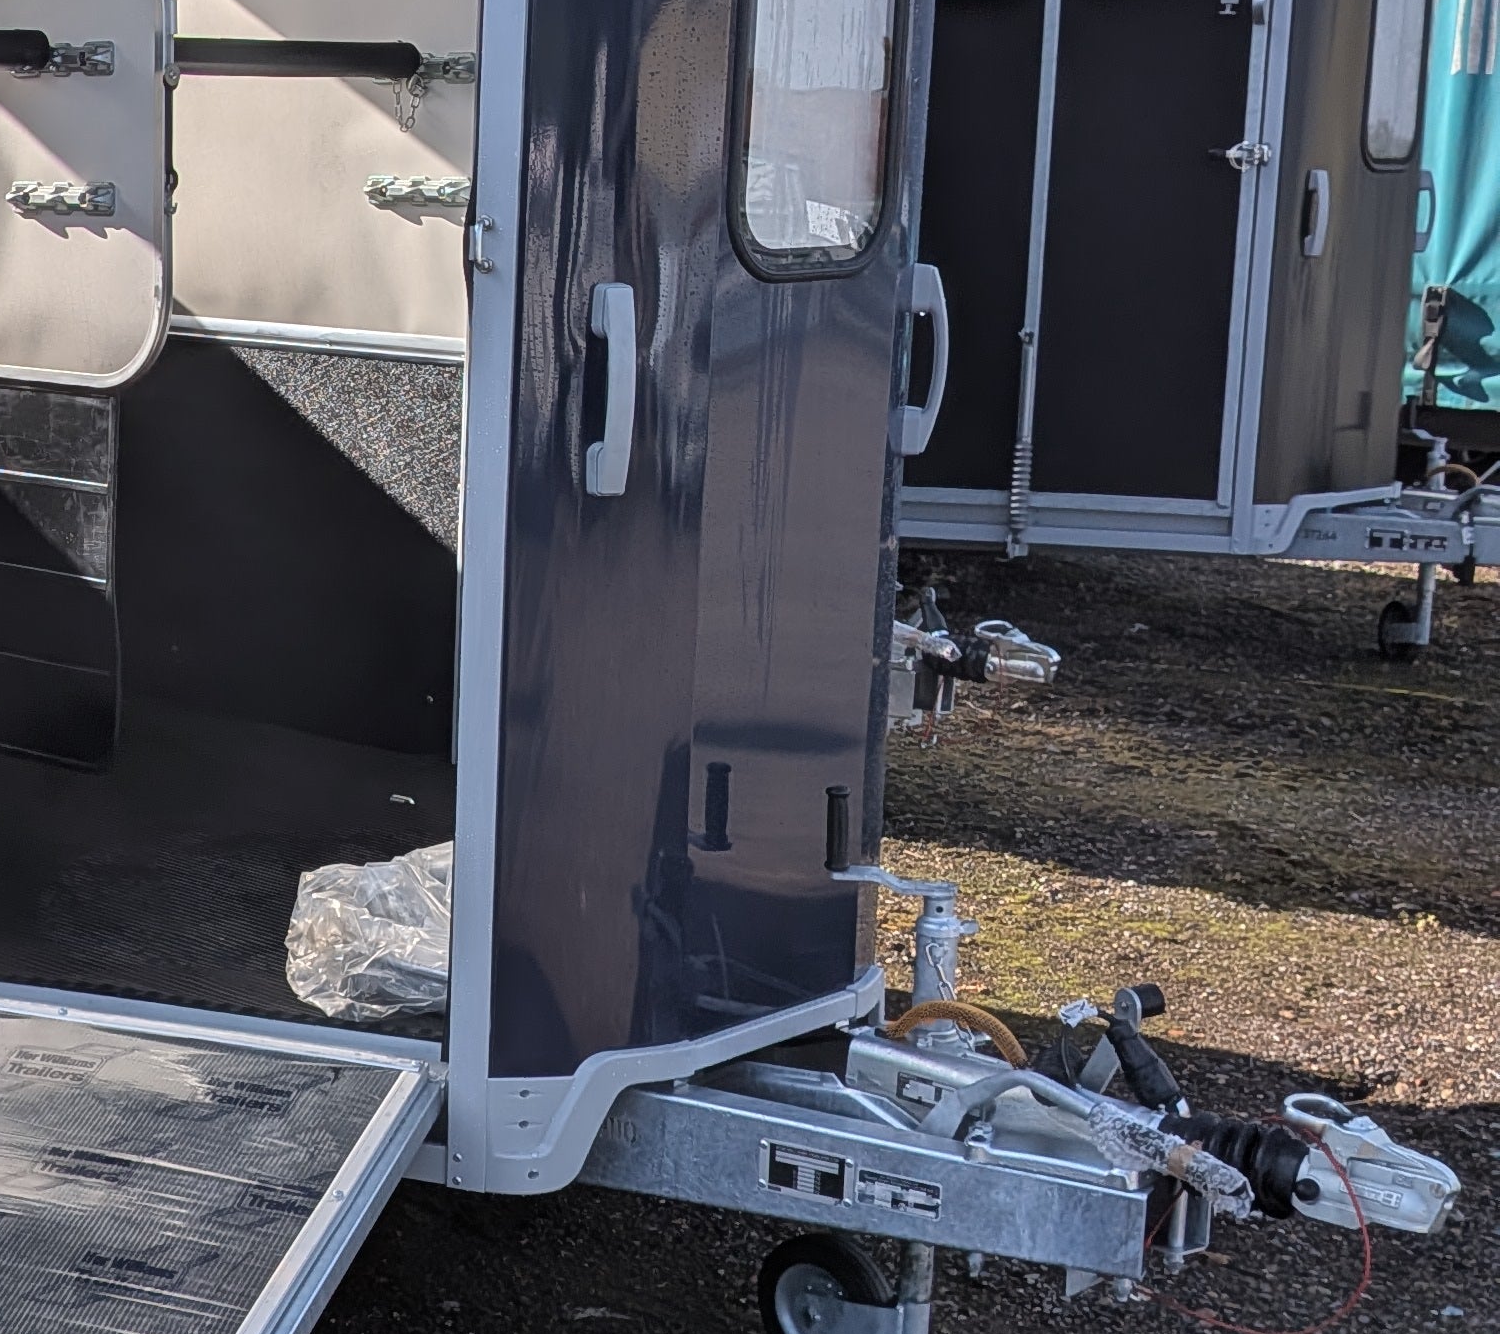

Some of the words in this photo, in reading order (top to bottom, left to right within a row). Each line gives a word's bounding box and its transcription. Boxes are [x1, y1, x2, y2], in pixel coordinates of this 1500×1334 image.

[15, 1050, 38, 1063] Ifor
[39, 1052, 97, 1069] Williams
[7, 1062, 89, 1082] Trailers
[233, 1080, 294, 1098] Williams
[205, 1091, 285, 1112] Trailers
[40, 1161, 123, 1183] Trailers
